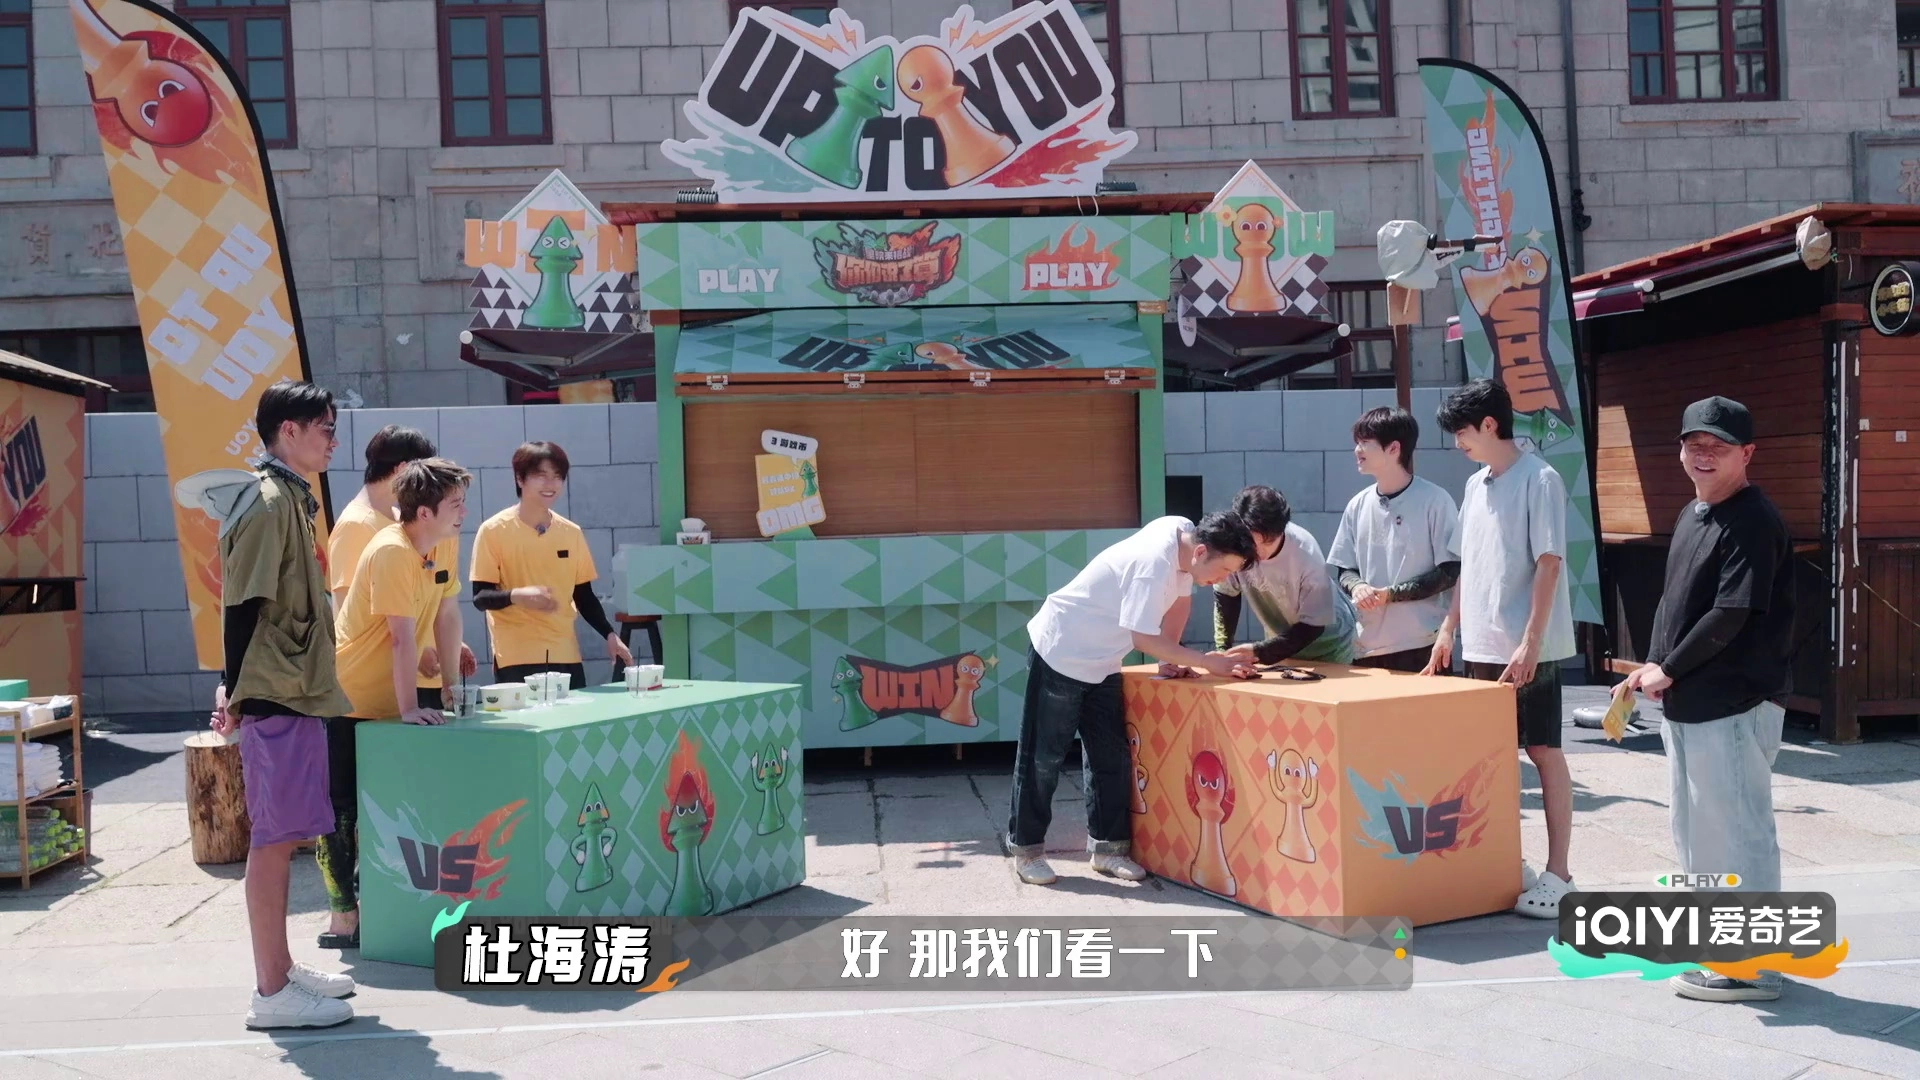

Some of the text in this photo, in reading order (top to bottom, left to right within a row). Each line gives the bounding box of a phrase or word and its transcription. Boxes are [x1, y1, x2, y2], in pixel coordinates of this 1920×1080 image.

[707, 9, 1102, 191] UP TO YOU
[698, 268, 780, 294] PLAY
[1029, 262, 1109, 287] PLAY
[759, 497, 824, 536] OMG
[859, 664, 954, 712] WIN
[1382, 794, 1464, 854] VS
[397, 836, 480, 893] VS
